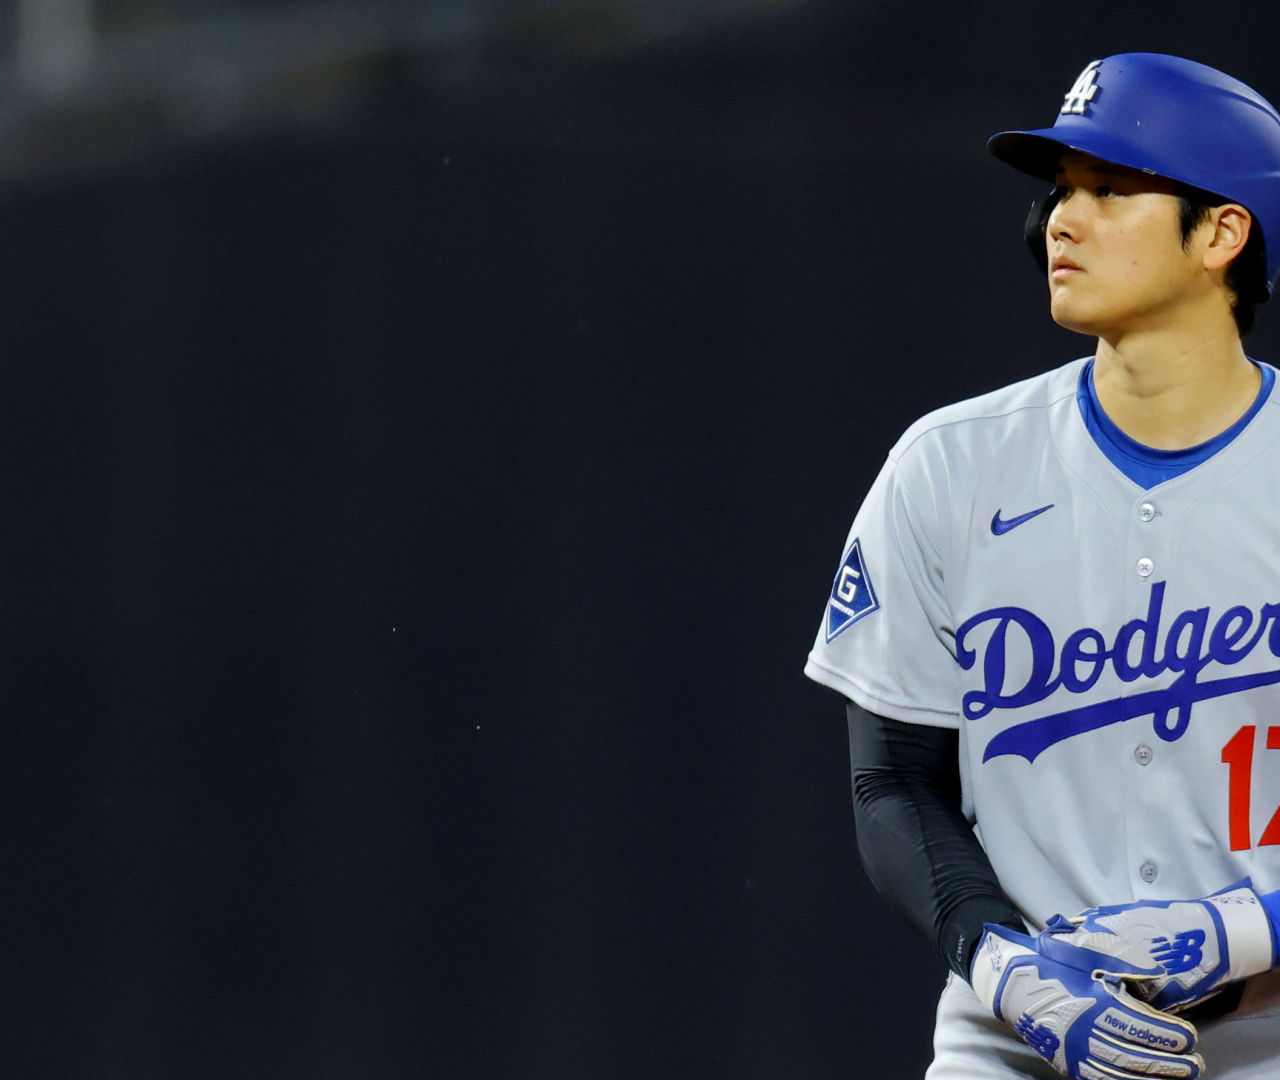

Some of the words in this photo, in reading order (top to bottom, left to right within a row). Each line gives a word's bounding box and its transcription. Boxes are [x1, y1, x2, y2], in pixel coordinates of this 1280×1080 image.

[1061, 59, 1102, 114] LA
[837, 565, 860, 603] G
[1104, 1013, 1128, 1031] new
[1128, 1024, 1178, 1049] balance
